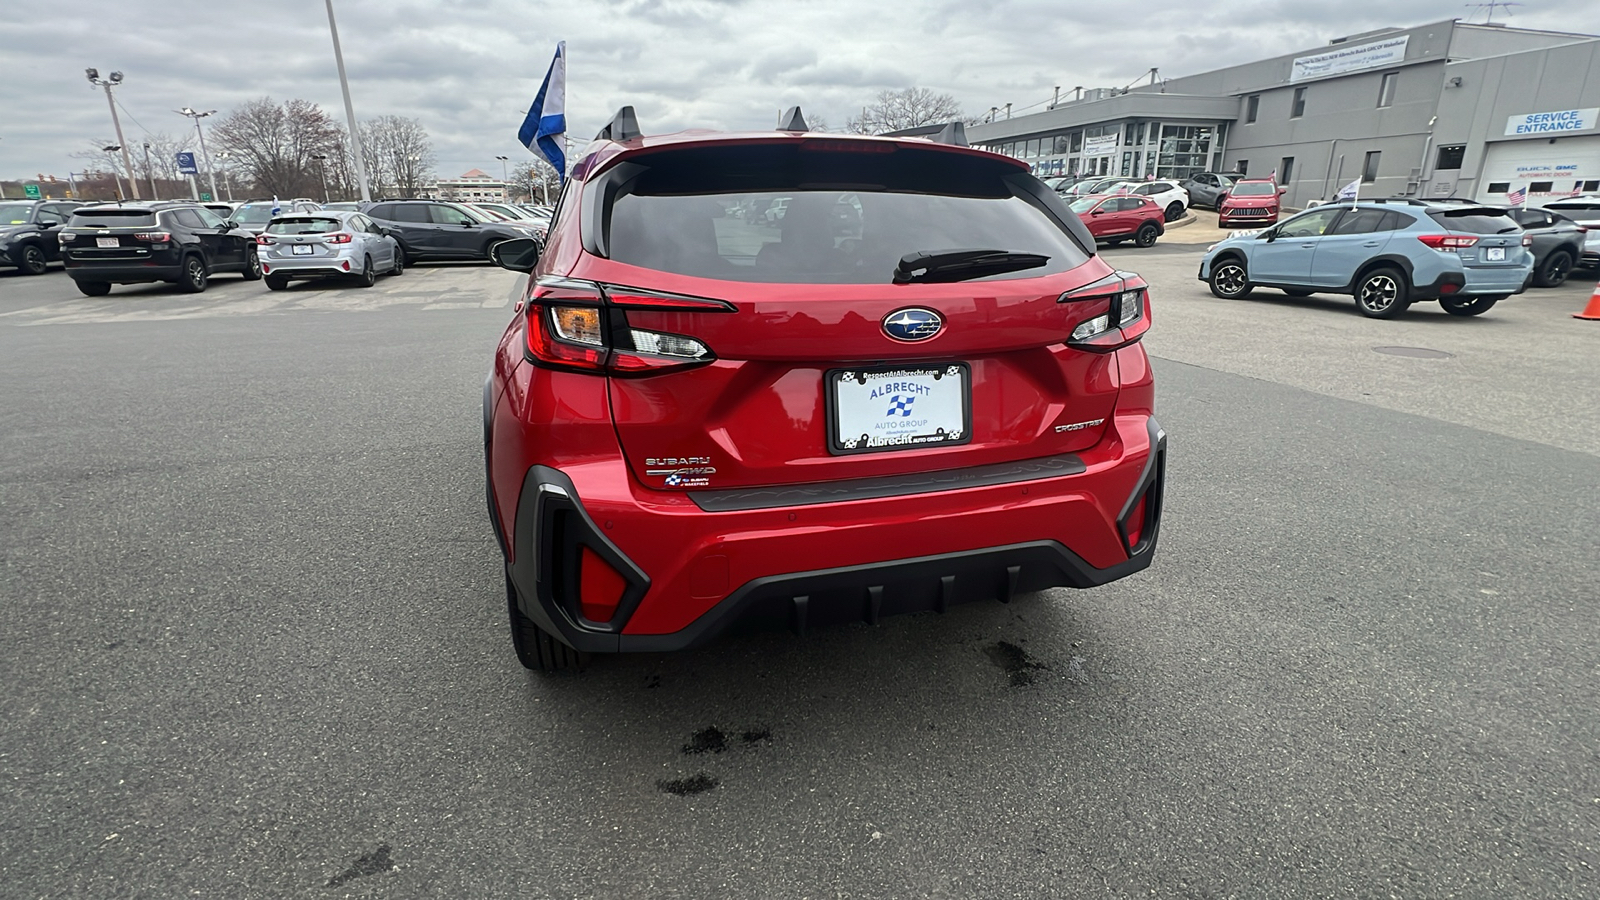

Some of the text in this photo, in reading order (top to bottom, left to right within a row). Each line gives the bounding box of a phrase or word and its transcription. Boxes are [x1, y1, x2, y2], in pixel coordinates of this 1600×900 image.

[1526, 111, 1578, 124] SERVICE
[1516, 120, 1582, 133] ENTRANCE
[863, 369, 939, 380] RespectAtAlbrecht.com
[869, 381, 931, 400] ALBRECHT
[874, 419, 928, 430] AUTO GROUP
[866, 434, 913, 448] Albrecht
[645, 456, 711, 466] SUBARU
